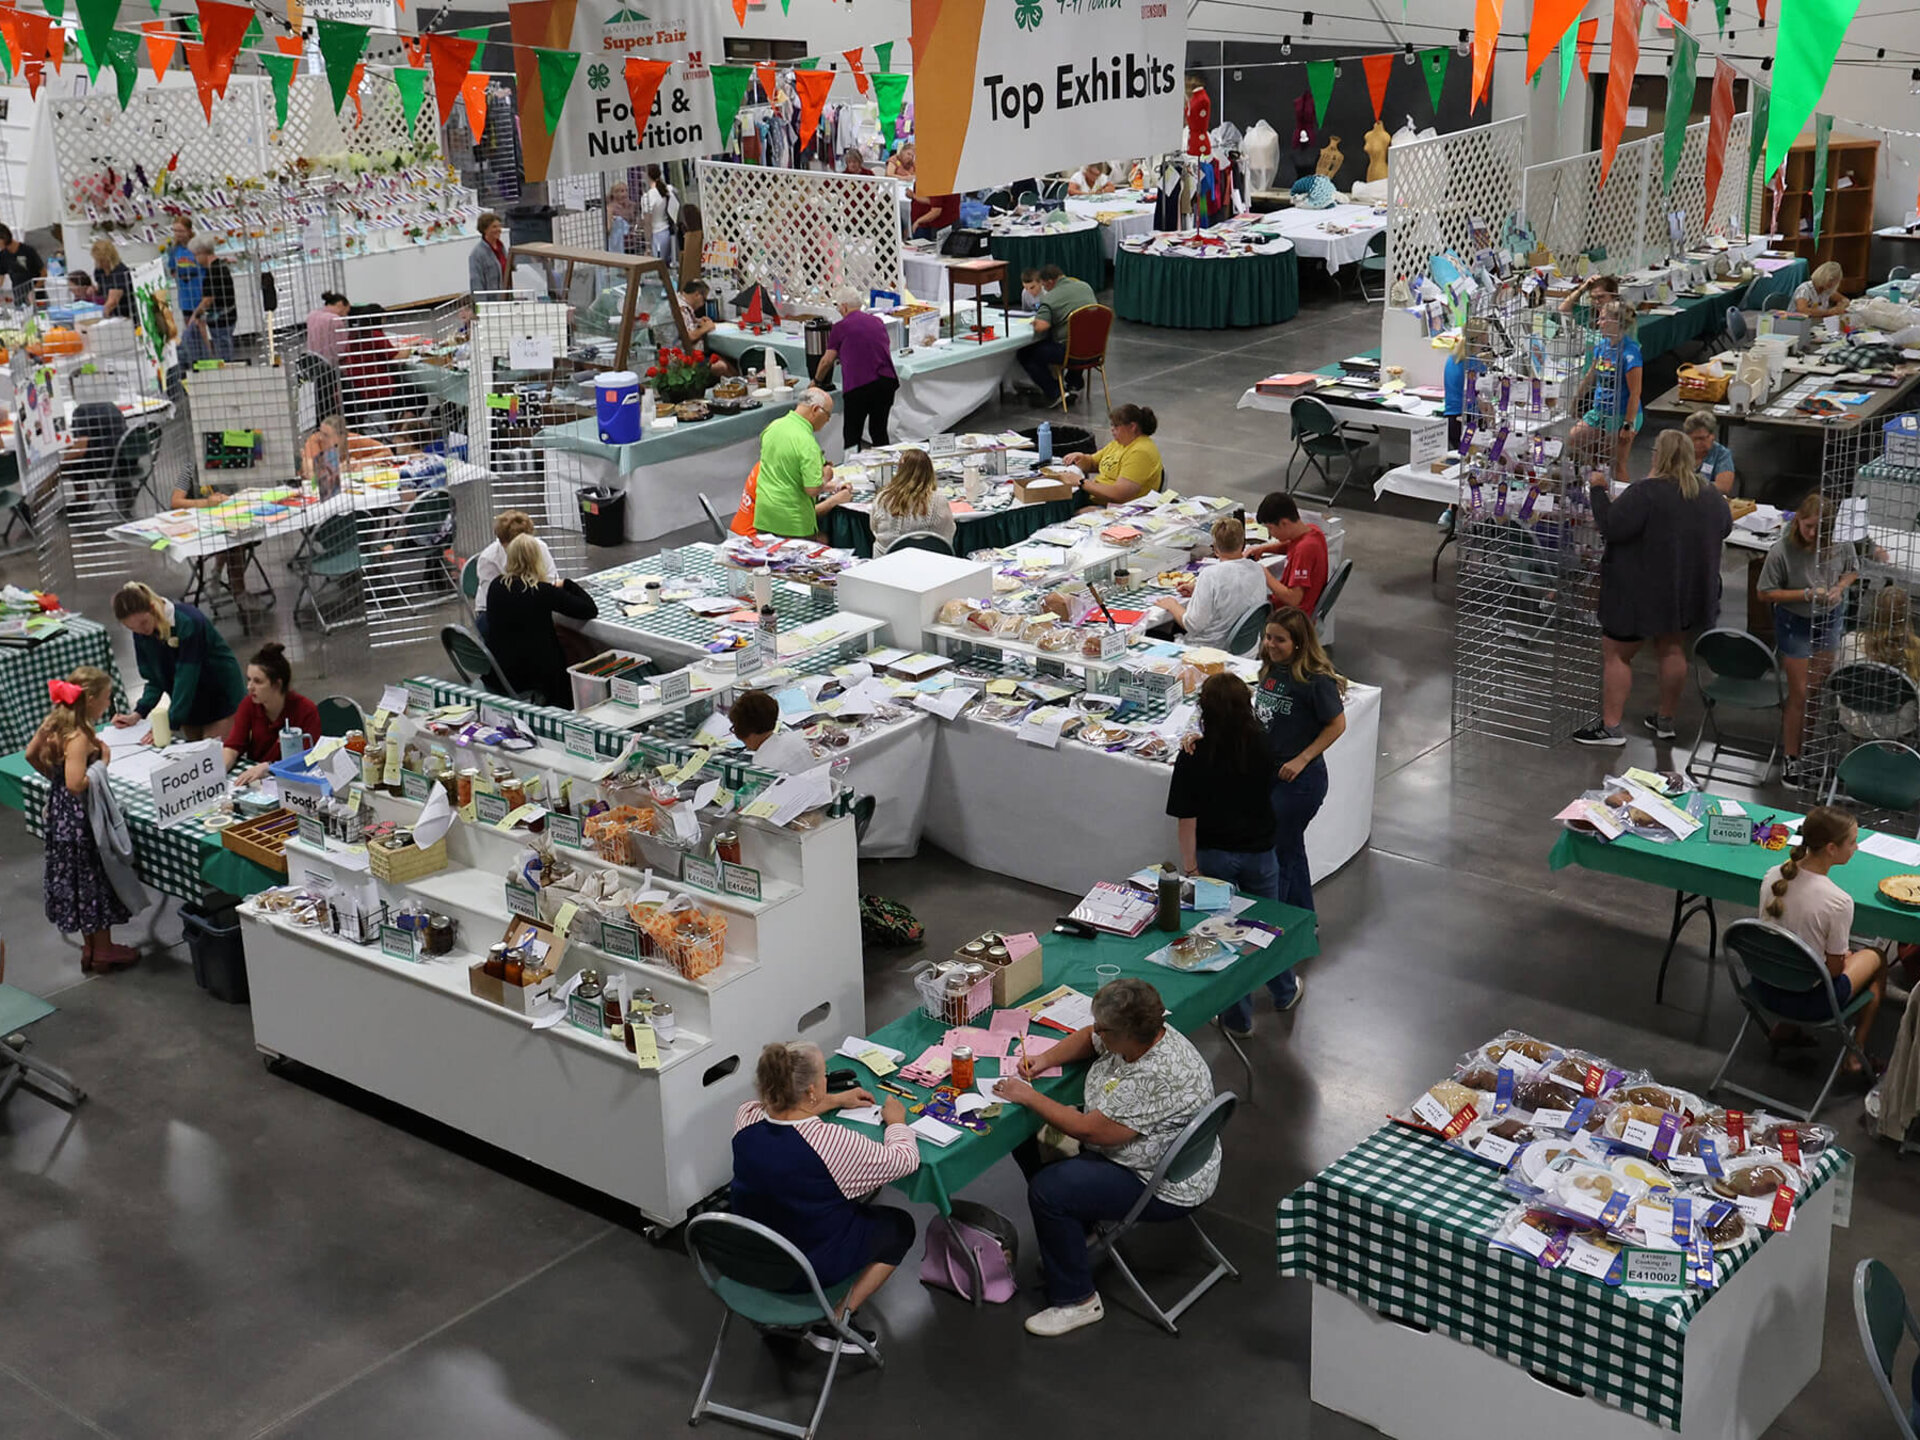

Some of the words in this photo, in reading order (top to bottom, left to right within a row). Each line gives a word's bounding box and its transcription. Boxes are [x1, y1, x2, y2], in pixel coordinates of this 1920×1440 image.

[323, 9, 373, 20] Technology
[603, 36, 654, 52] Super
[656, 29, 687, 44] Fair
[596, 89, 662, 124] Fod
[671, 88, 691, 113] &
[984, 74, 1044, 129] Top
[588, 121, 703, 157] Nutrition
[161, 763, 199, 794] Food
[202, 758, 214, 774] &
[159, 782, 225, 821] Nutrition
[284, 790, 318, 810] Foods
[1713, 829, 1746, 838] E410001
[1628, 1270, 1677, 1282] E410002
